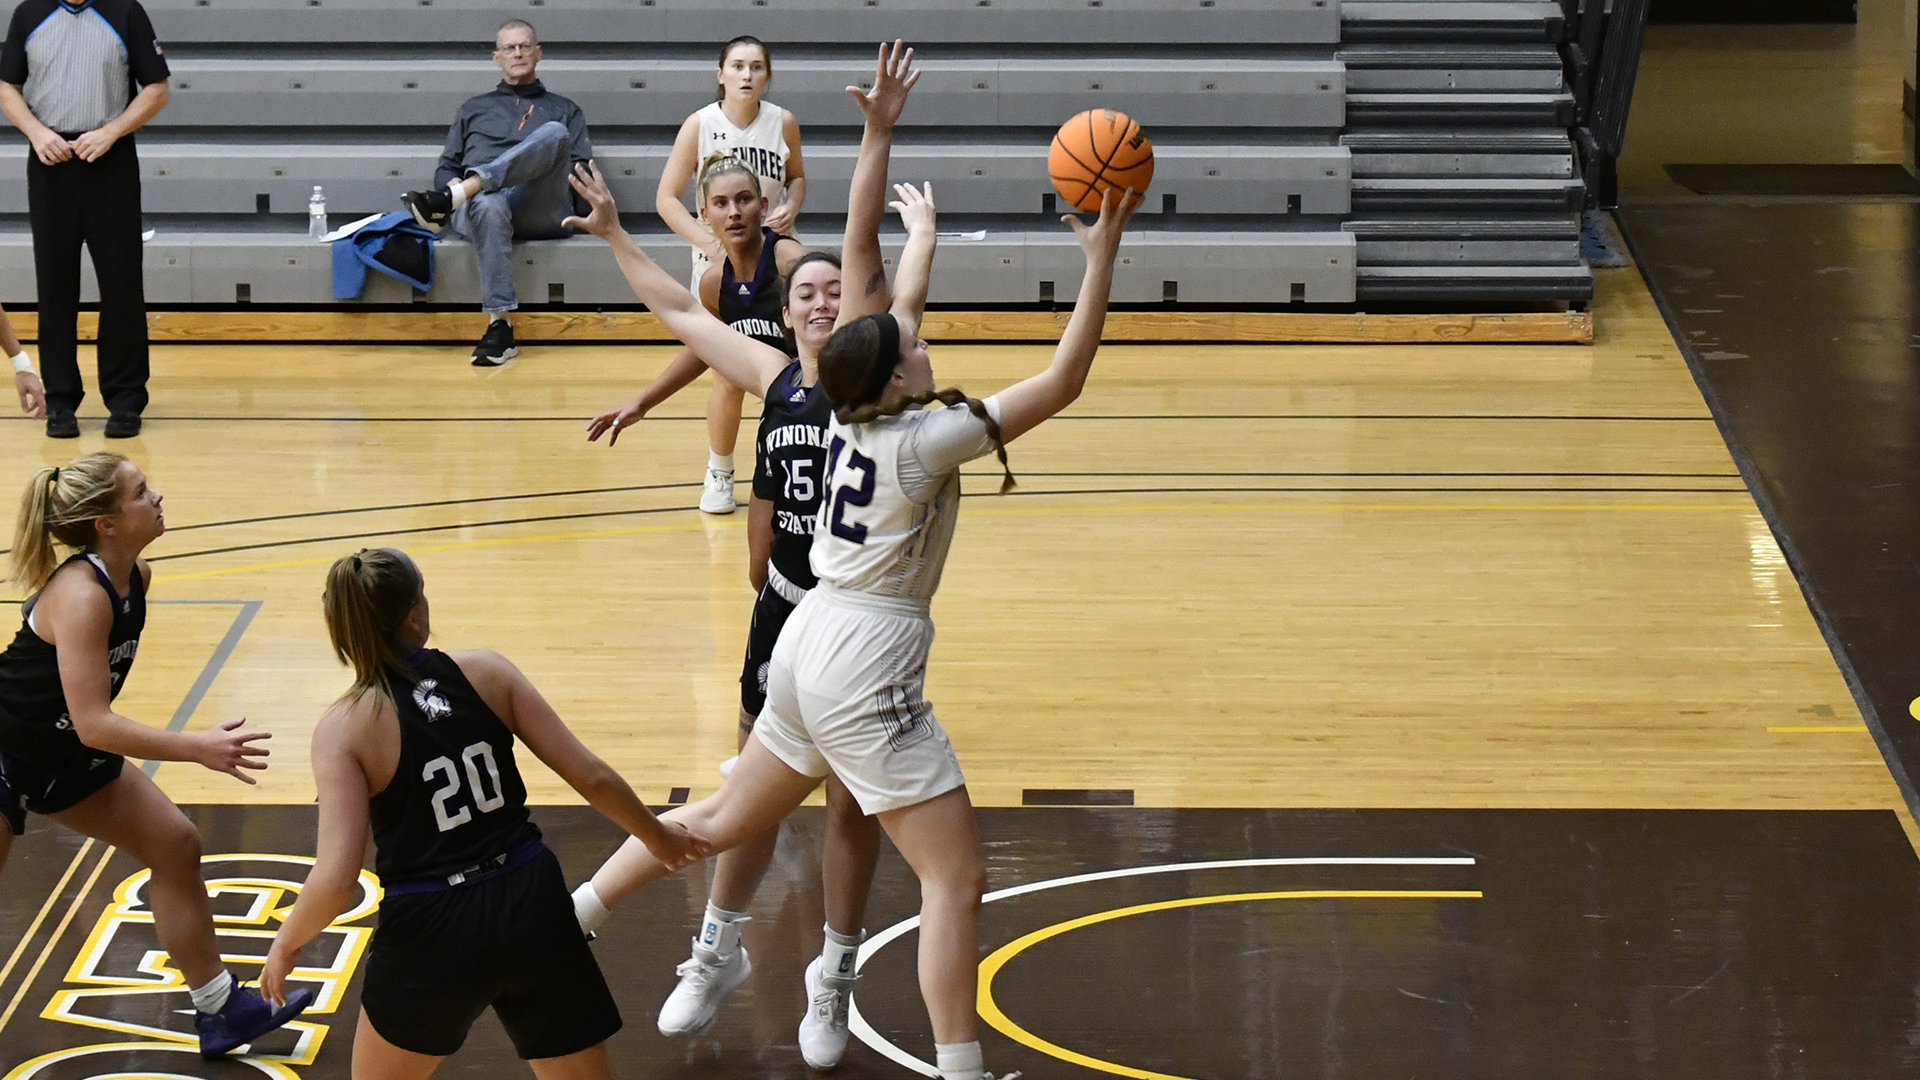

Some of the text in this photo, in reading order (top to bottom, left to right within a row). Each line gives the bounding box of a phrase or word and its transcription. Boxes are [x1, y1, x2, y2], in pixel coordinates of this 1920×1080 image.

[781, 459, 814, 501] 15
[777, 510, 817, 535] STAT
[422, 740, 505, 833] 20
